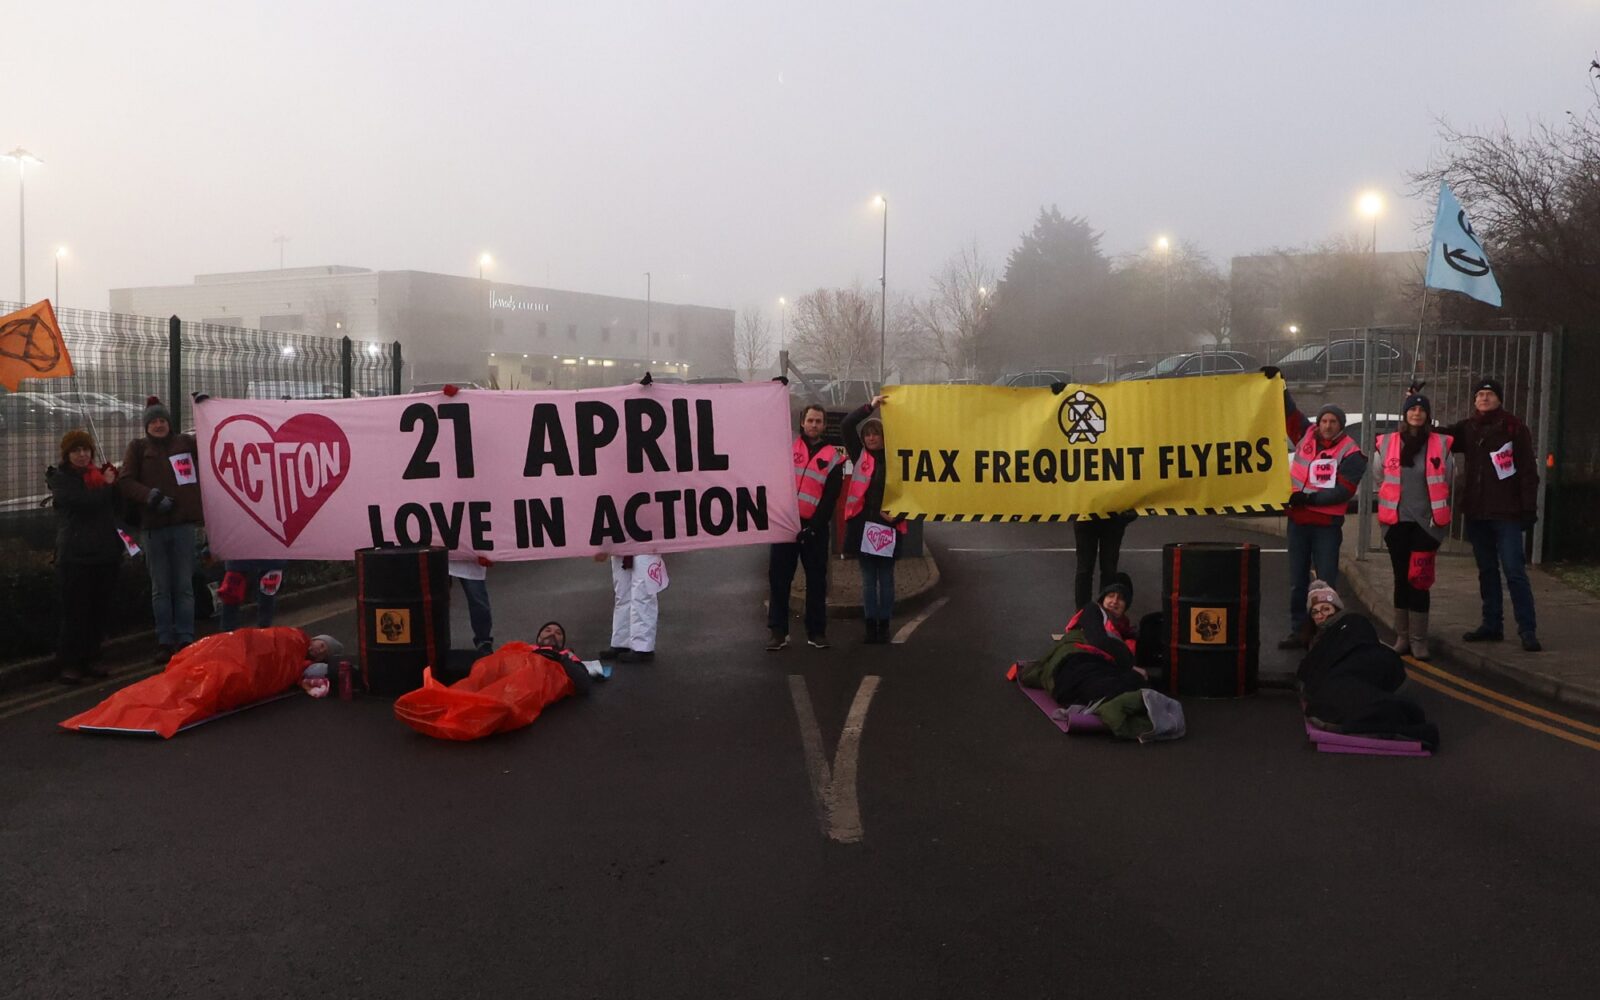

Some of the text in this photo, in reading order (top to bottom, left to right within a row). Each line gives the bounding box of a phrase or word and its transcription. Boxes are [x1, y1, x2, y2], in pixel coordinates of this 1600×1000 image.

[400, 398, 729, 480] 21 APRIL
[897, 437, 1273, 485] TAX FREQUENT FLYERS
[217, 441, 341, 524] ACTION
[368, 485, 769, 550] LOVE IN ACTION
